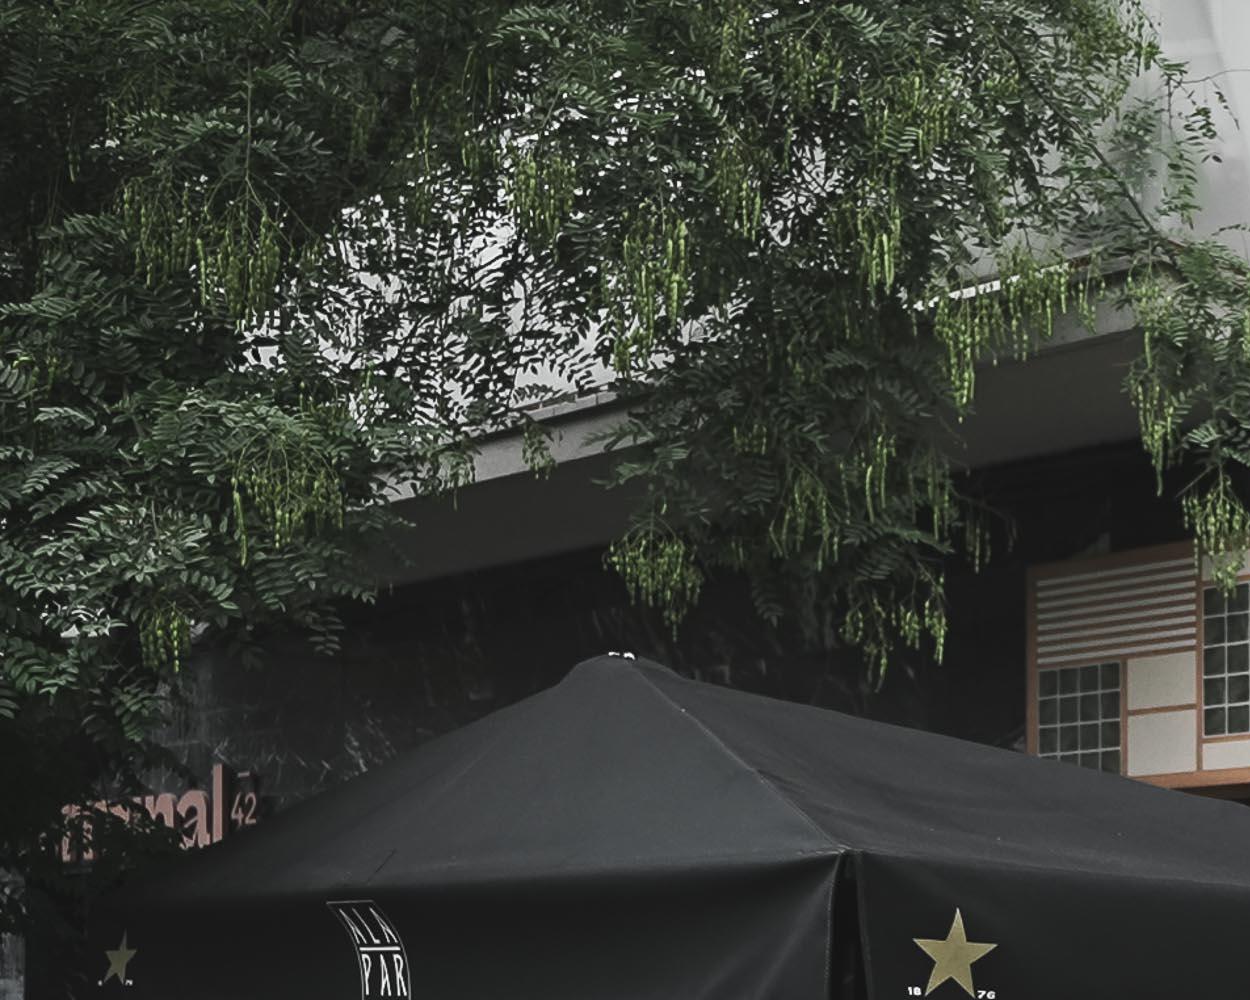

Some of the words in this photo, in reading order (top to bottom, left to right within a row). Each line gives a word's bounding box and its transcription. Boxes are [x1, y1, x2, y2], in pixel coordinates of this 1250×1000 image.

[230, 792, 258, 826] 42
[339, 907, 399, 945] ALA
[360, 953, 408, 998] PAR
